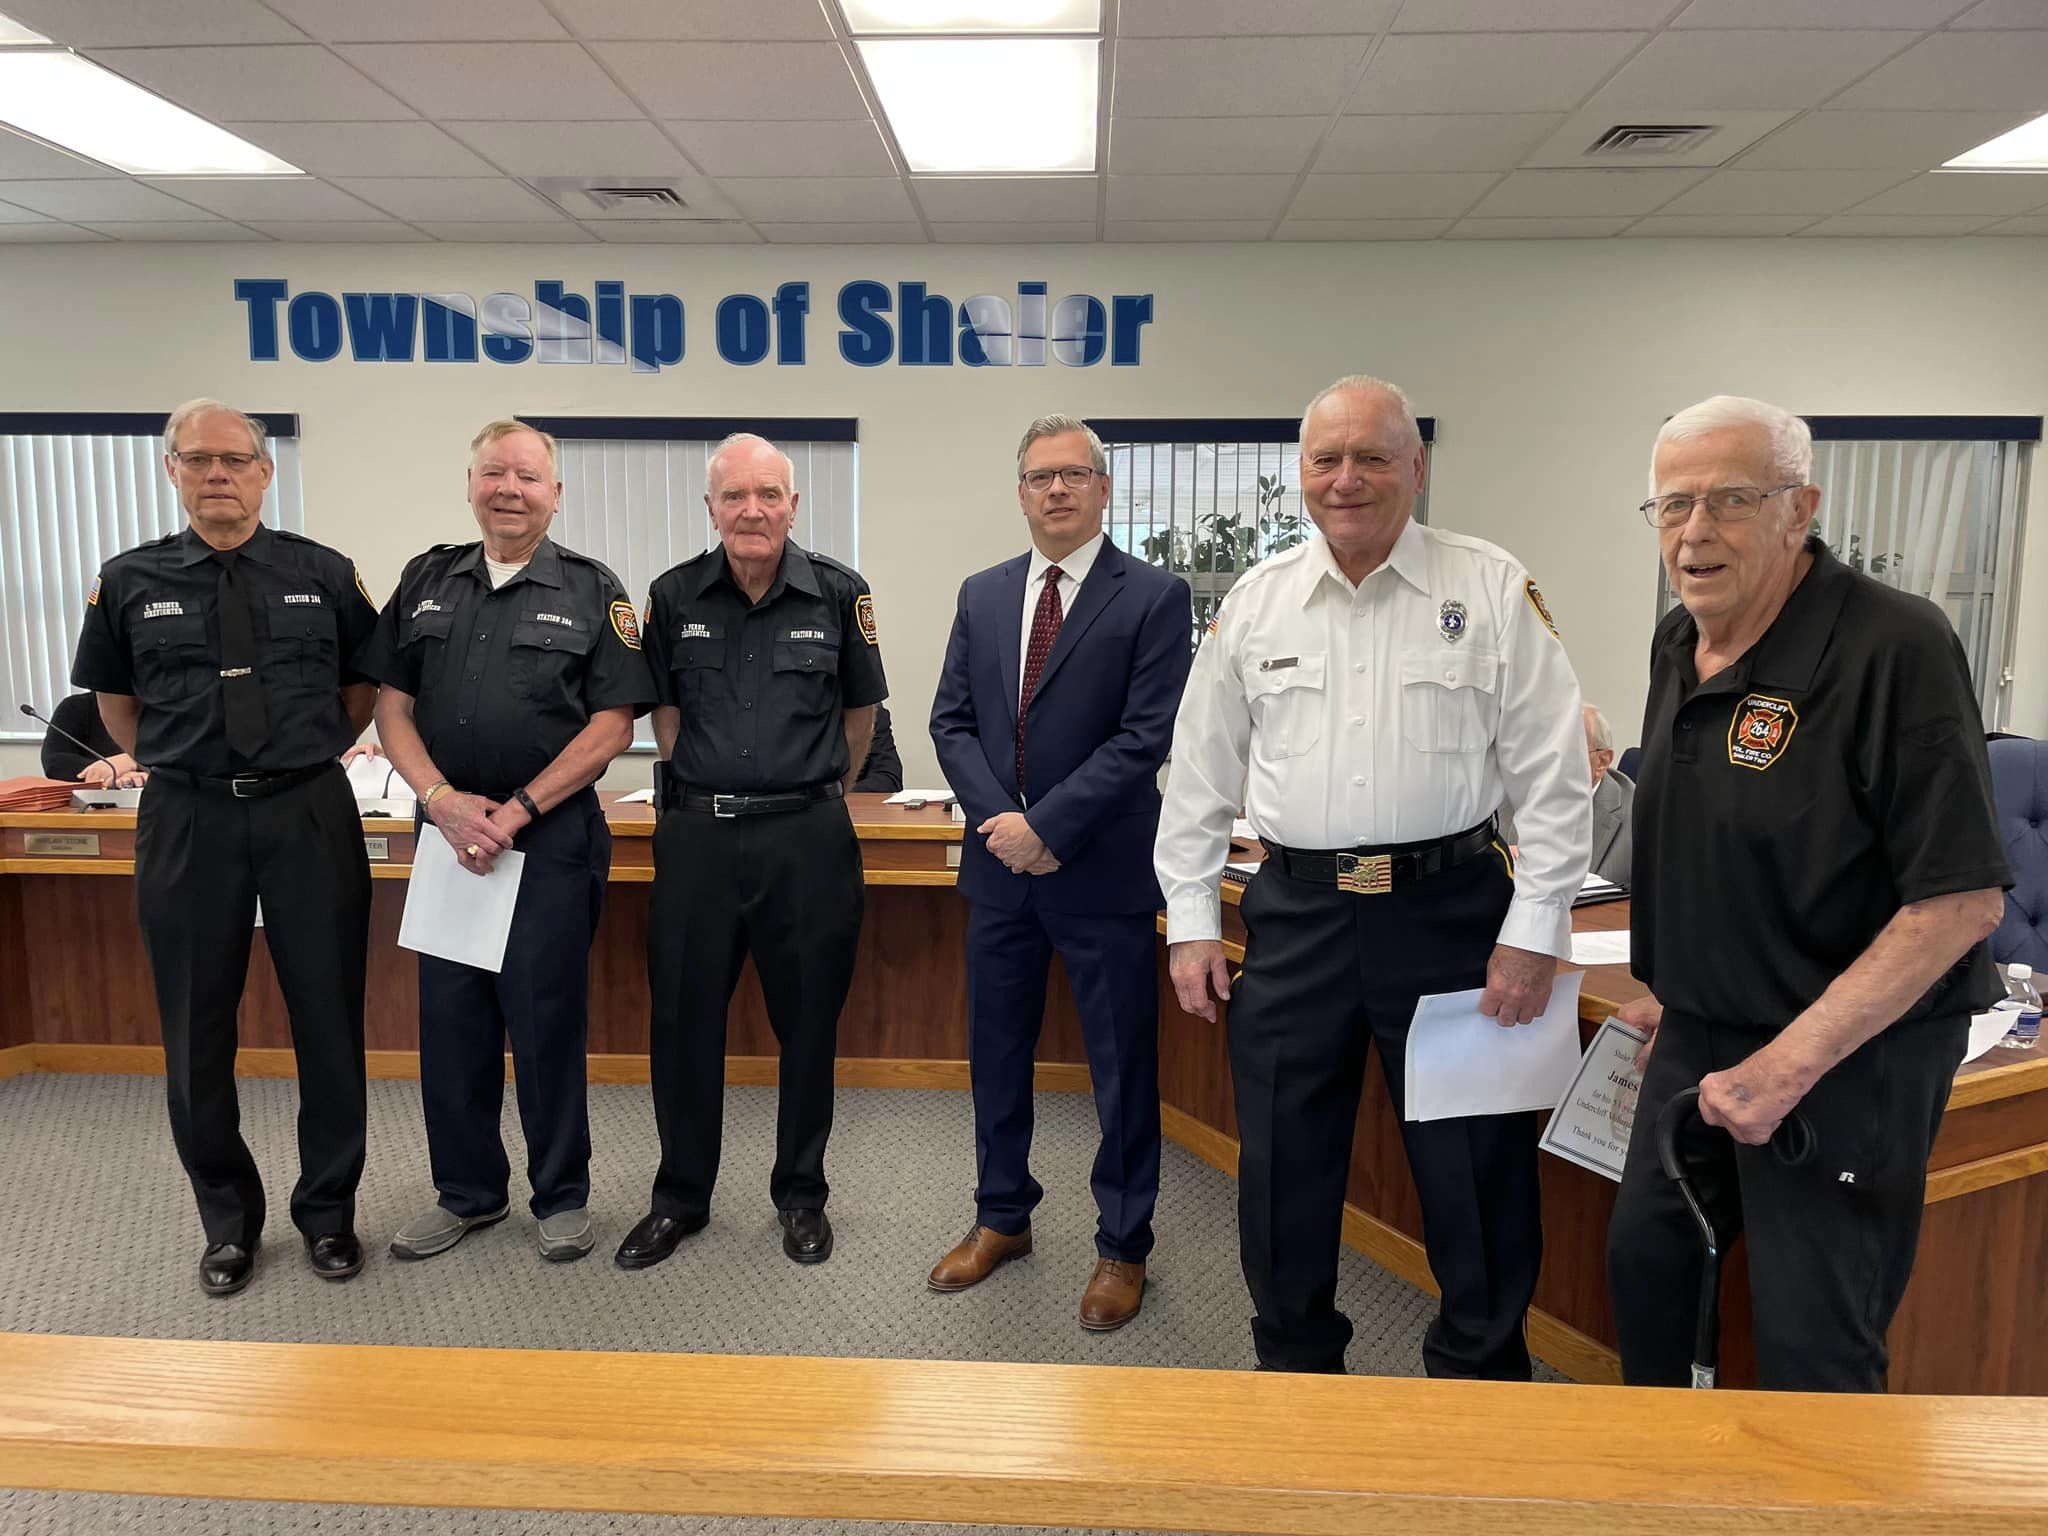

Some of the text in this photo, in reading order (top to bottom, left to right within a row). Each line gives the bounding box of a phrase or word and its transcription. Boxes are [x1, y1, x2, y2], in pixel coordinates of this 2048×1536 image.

[234, 279, 1154, 373] Township of Shaler
[1750, 721, 1770, 737] 264
[1607, 1070, 1640, 1092] James
[1576, 1097, 1608, 1118] Undercliff
[1573, 1125, 1592, 1141] Thank
[1592, 1136, 1607, 1147] you
[1608, 1140, 1620, 1152] for
